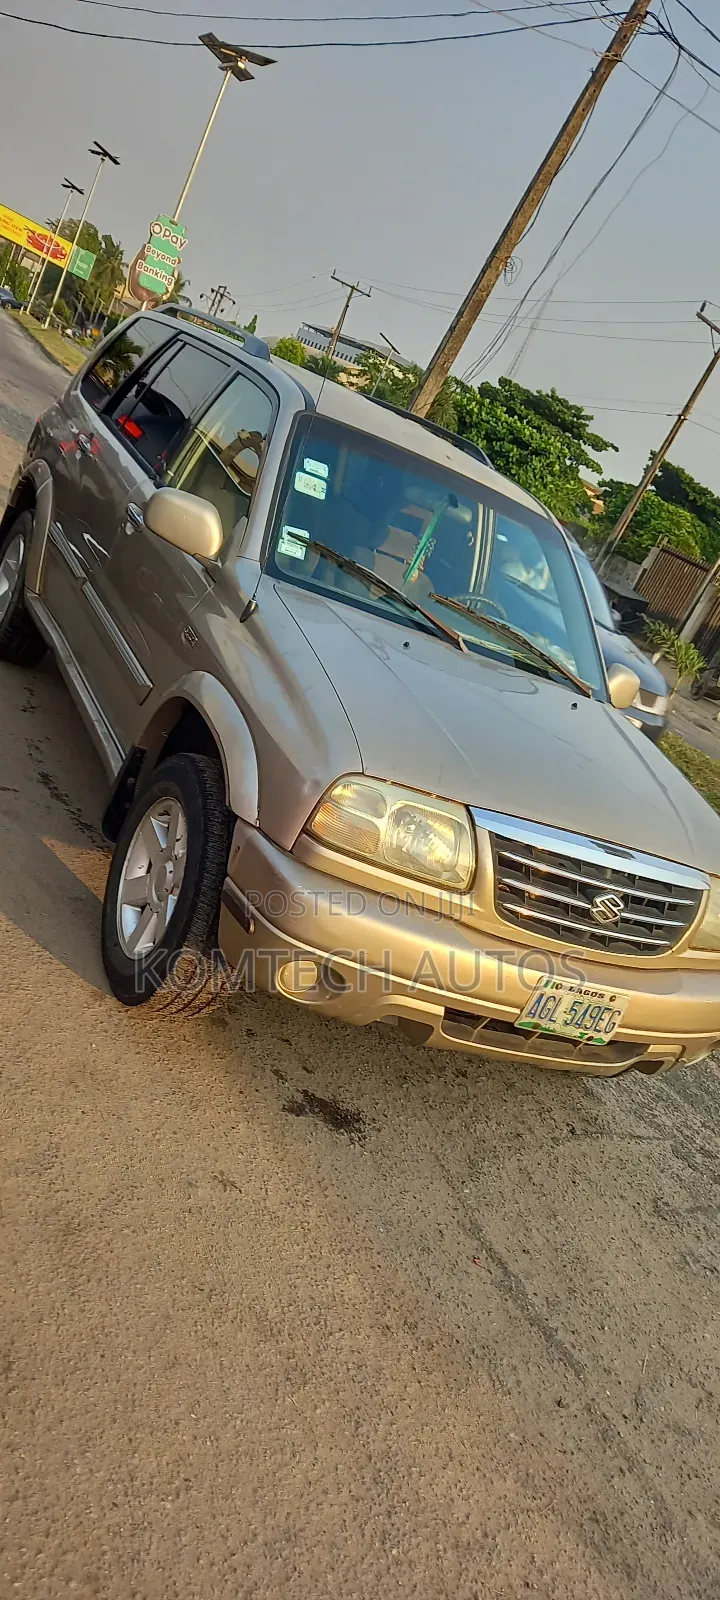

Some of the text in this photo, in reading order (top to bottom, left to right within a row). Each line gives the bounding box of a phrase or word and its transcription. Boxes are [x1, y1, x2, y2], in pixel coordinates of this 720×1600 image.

[151, 222, 187, 249] OPay
[145, 245, 177, 266] Beyond
[137, 261, 174, 286] Banking
[567, 986, 606, 999] LAGOS
[526, 992, 622, 1034] AGL 549EG
